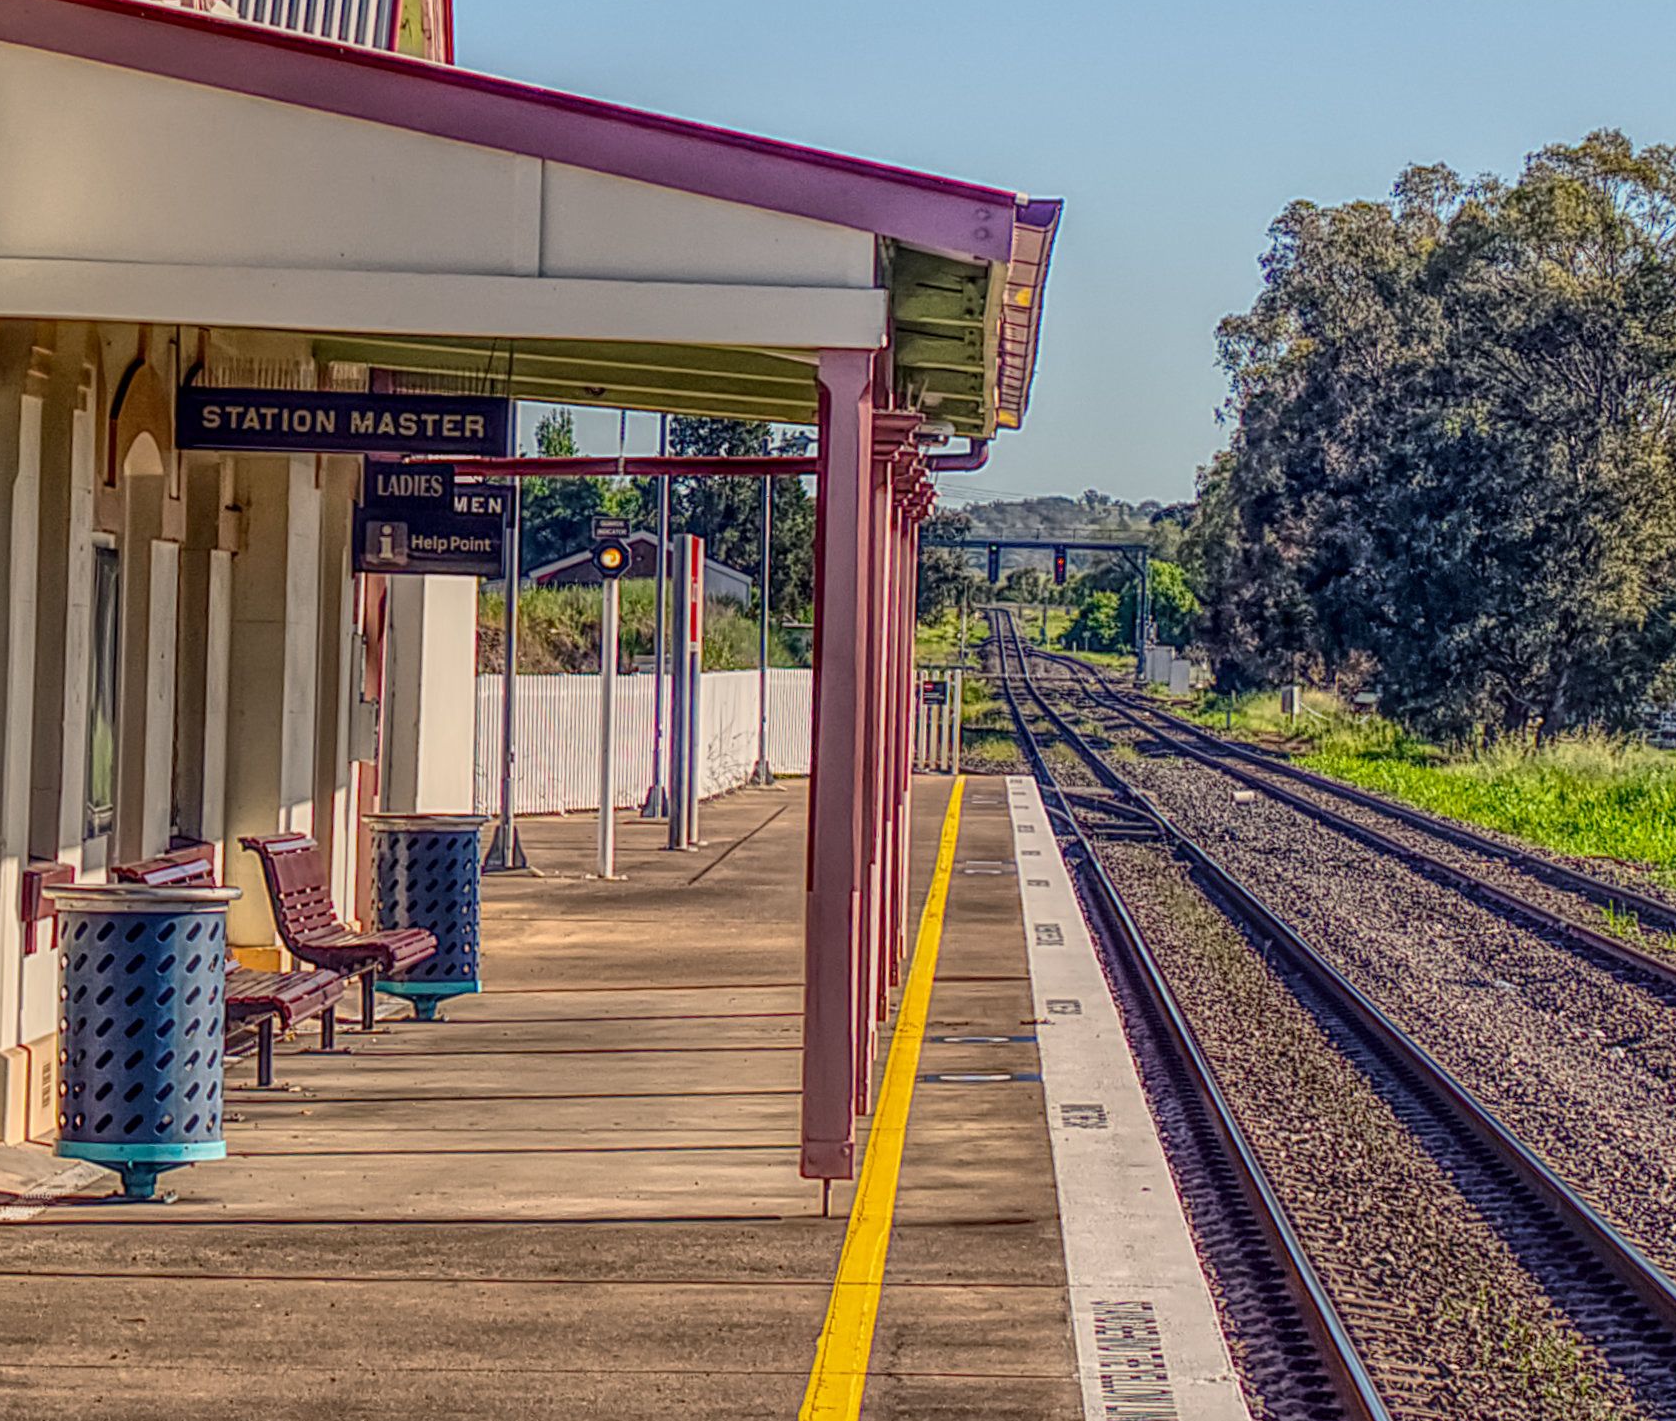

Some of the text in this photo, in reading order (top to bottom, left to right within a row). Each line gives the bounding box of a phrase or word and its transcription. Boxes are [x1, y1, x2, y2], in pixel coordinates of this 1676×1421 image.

[202, 405, 485, 438] STATION MASTER
[377, 474, 443, 498] LADIES
[454, 496, 502, 514] MEN
[411, 535, 491, 555] Help Point
[1098, 1369, 1174, 1404] YELLOW
